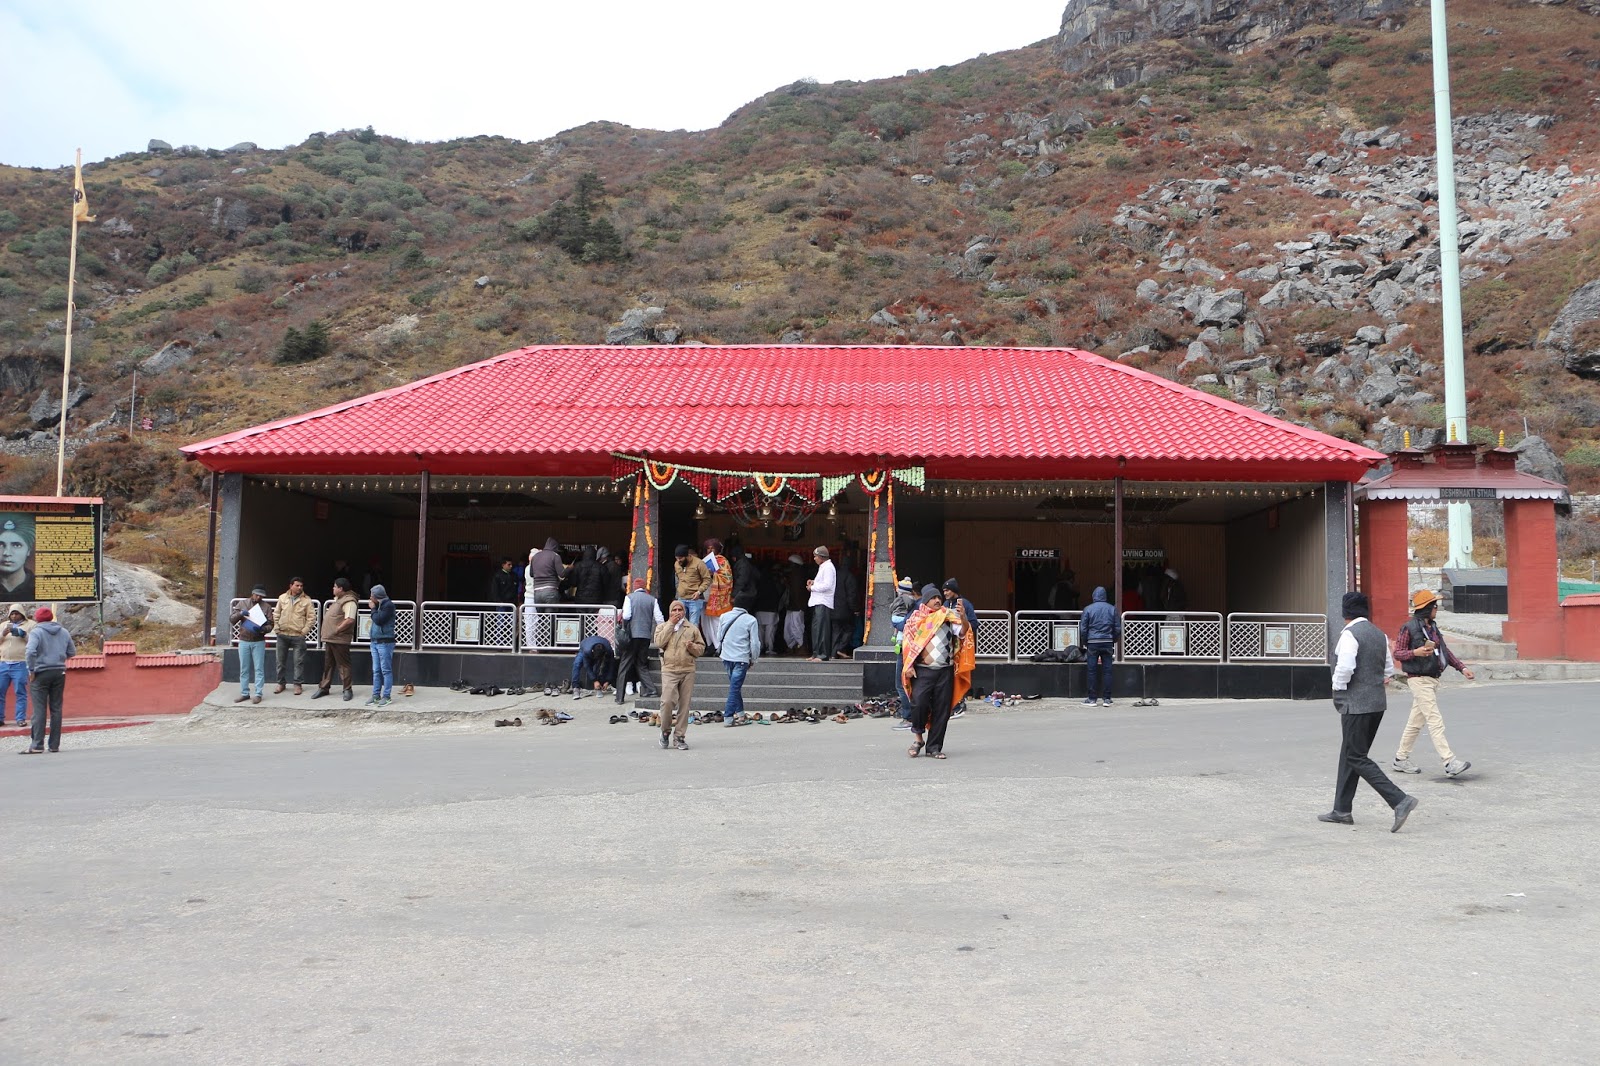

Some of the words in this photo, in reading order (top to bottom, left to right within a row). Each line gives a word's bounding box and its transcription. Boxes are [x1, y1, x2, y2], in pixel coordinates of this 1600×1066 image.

[1440, 488, 1476, 498] DESHBHAKTI
[1477, 488, 1496, 498] STHAL
[1021, 549, 1055, 557] OFFICE
[1122, 550, 1143, 558] LIVING
[1144, 550, 1164, 558] ROOM
